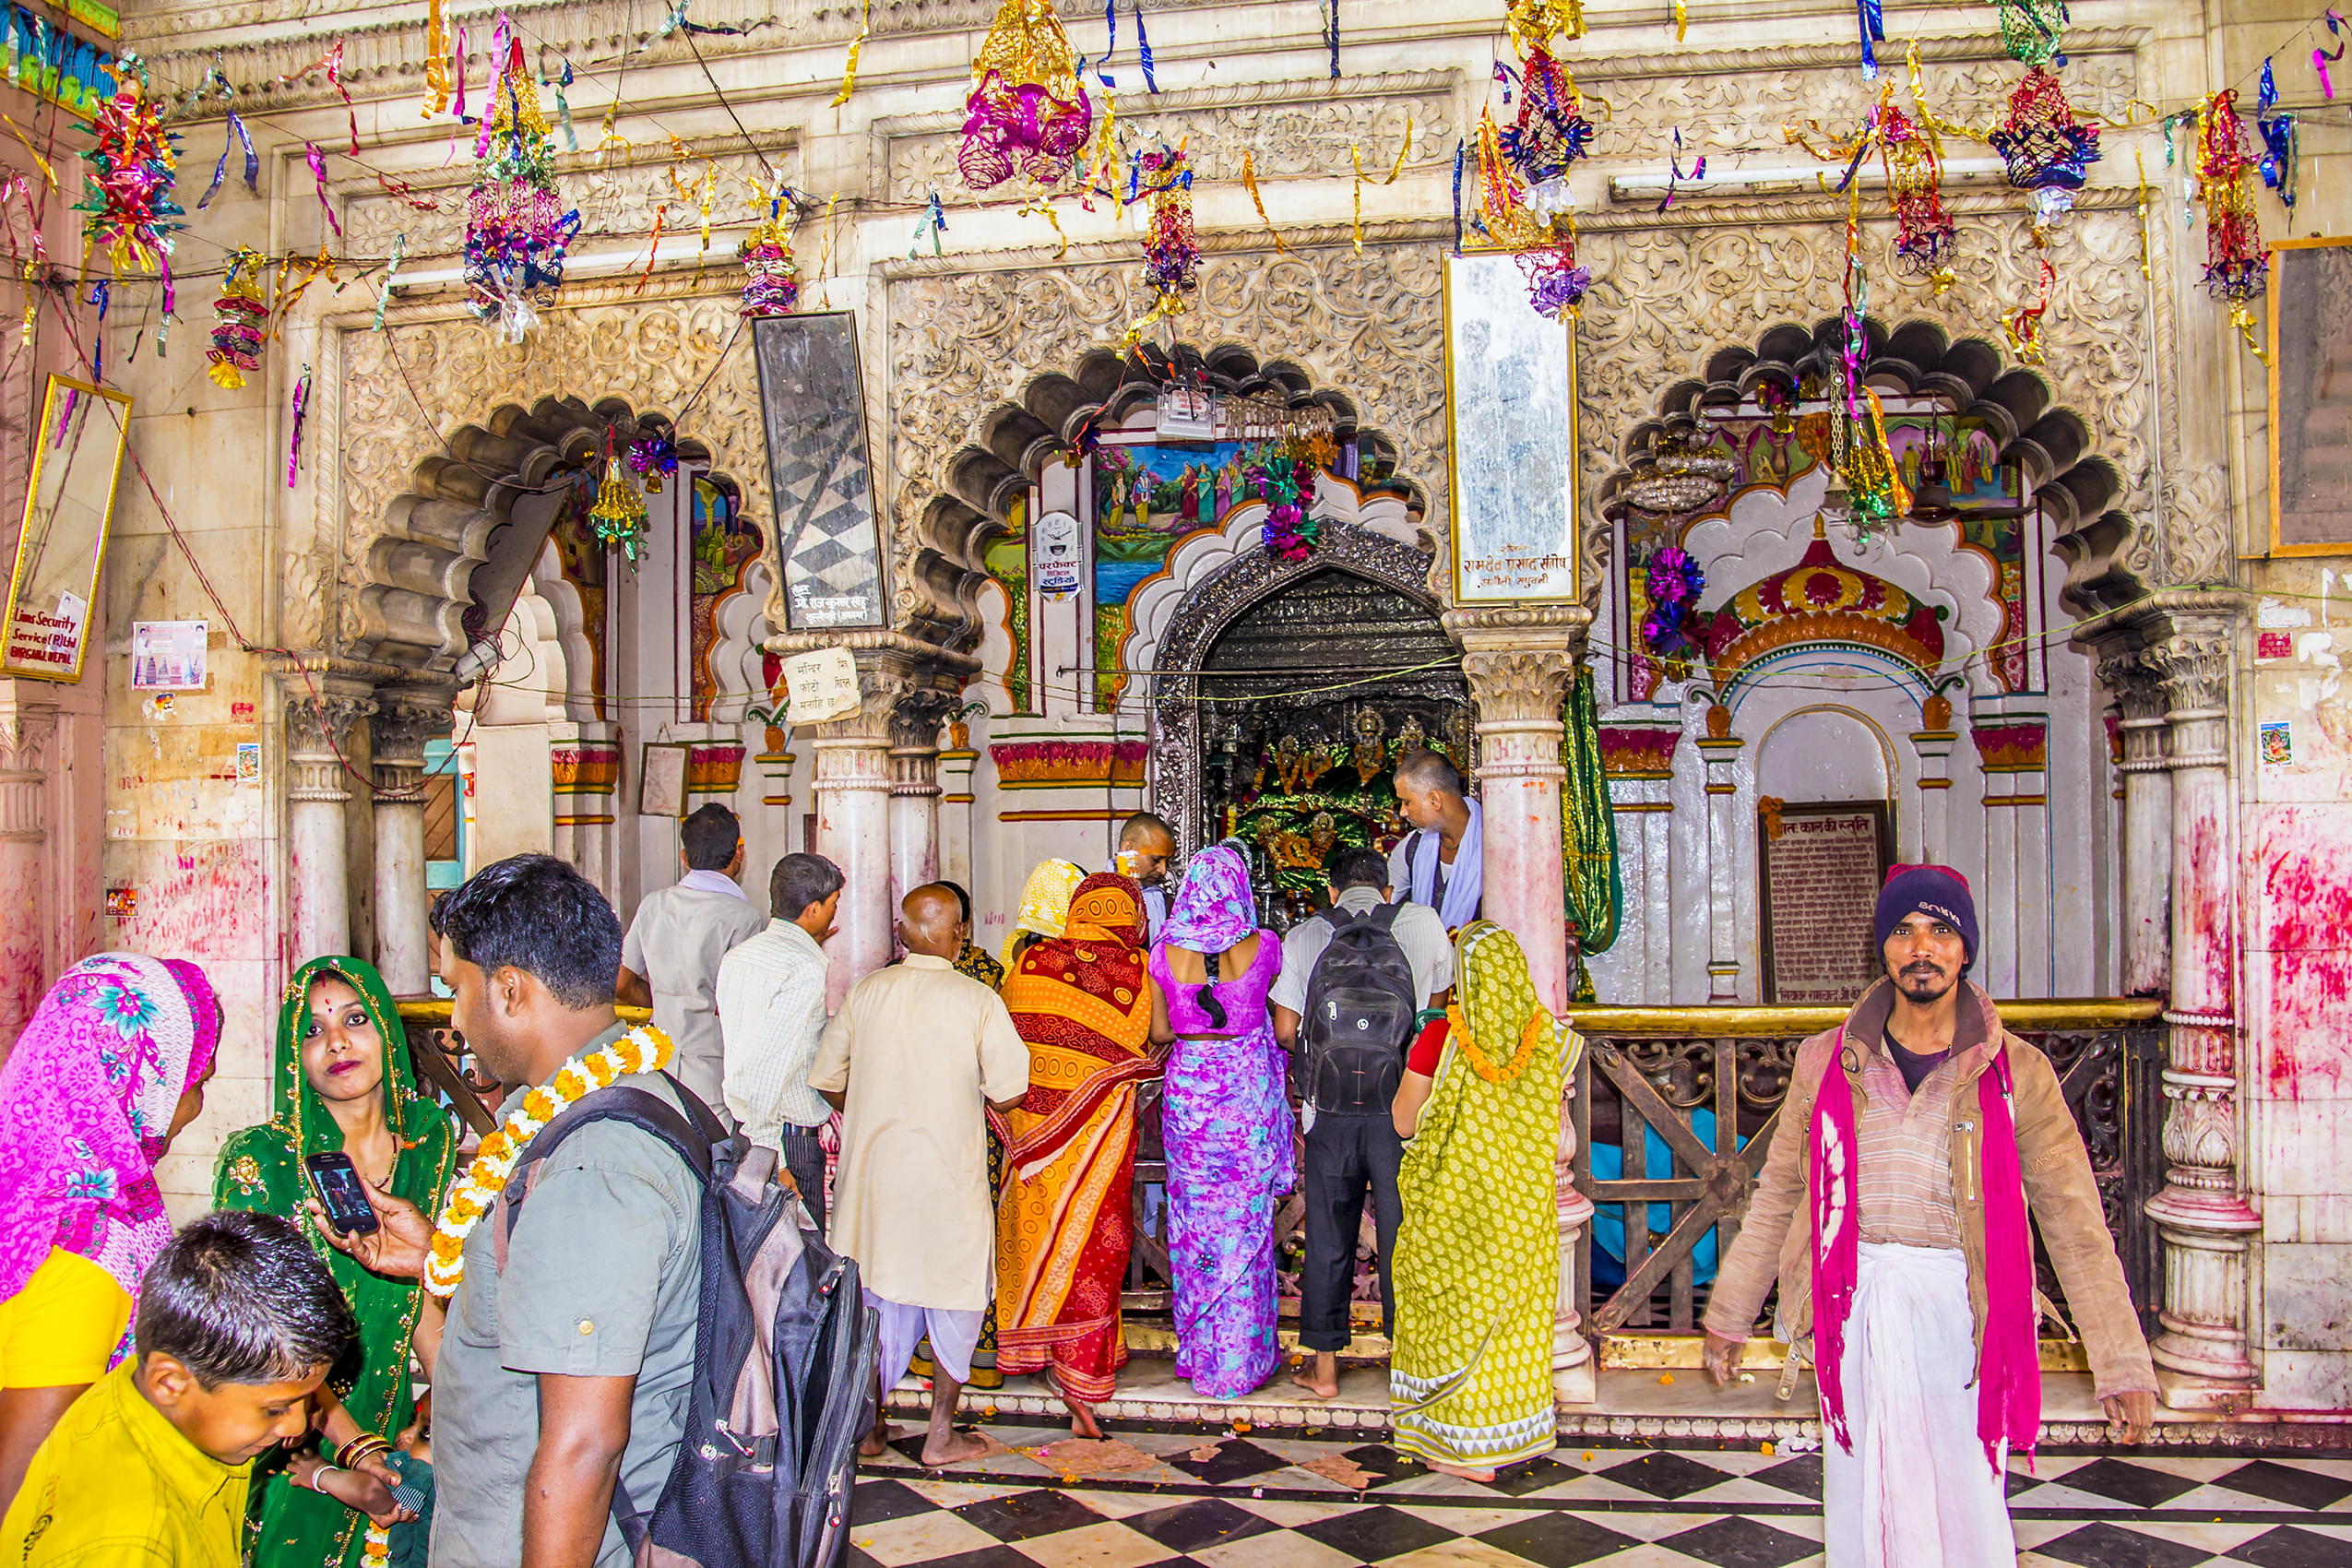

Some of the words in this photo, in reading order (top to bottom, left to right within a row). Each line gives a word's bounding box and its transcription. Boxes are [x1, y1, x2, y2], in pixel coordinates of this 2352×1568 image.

[1039, 561, 1076, 569] परफेक्ट
[1464, 554, 1503, 573] रामदेव
[1505, 557, 1539, 572] प्रसाद
[1539, 553, 1566, 570] संतोष
[36, 611, 77, 634] Security
[12, 628, 47, 643] Service
[48, 651, 71, 665] NEPAL
[800, 680, 819, 693] फोटो
[1800, 820, 1824, 835] काल
[1824, 817, 1836, 833] की
[1839, 816, 1868, 835] स्तुति
[1839, 986, 1849, 1001] जी
